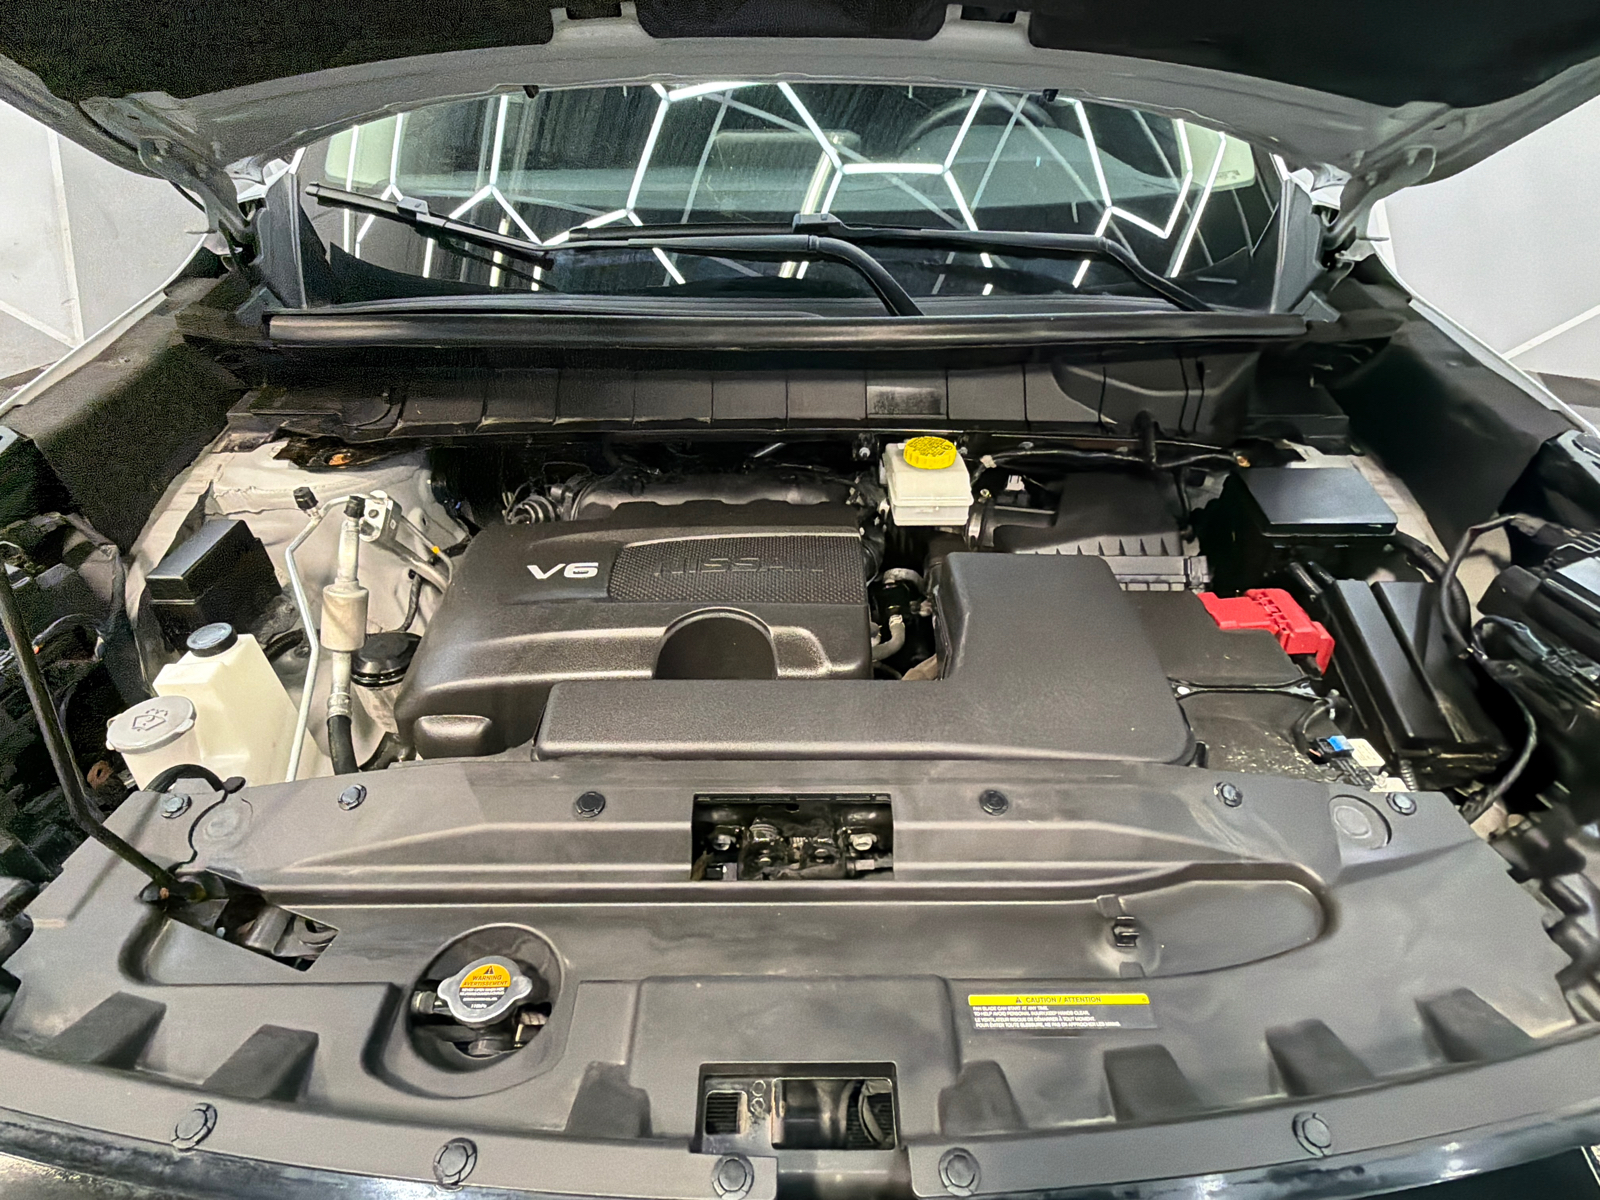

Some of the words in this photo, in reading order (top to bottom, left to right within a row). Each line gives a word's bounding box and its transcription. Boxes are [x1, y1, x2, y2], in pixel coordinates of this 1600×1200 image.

[526, 562, 599, 579] V6
[653, 557, 824, 576] NISSAN
[1025, 996, 1057, 1004] CAUTION
